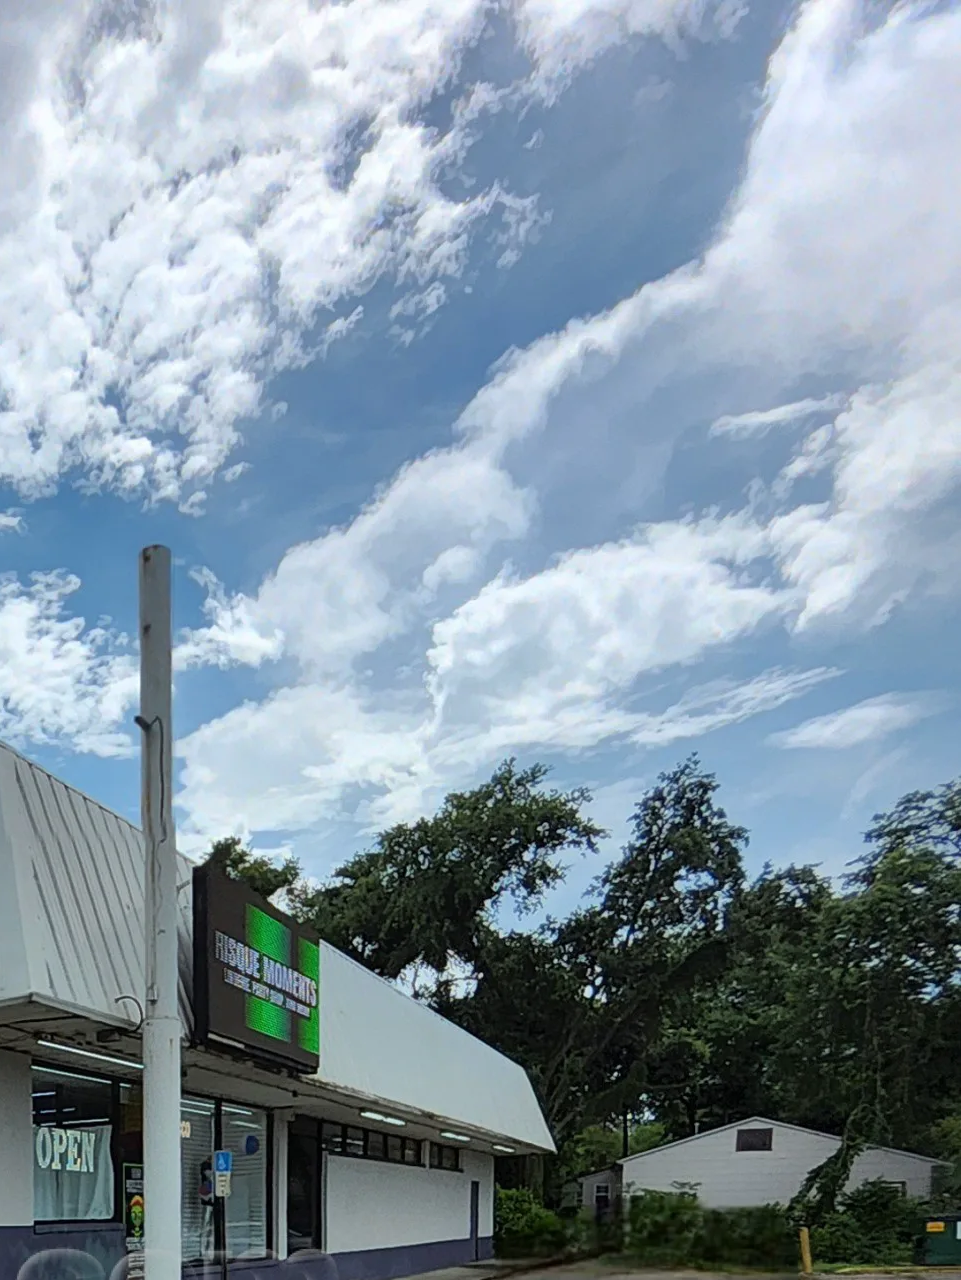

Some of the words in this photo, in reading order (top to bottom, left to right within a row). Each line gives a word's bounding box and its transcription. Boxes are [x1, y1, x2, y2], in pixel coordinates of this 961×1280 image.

[215, 931, 260, 978] RISQUE
[263, 956, 317, 1007] MOMENTS
[37, 1127, 96, 1173] OPEN
